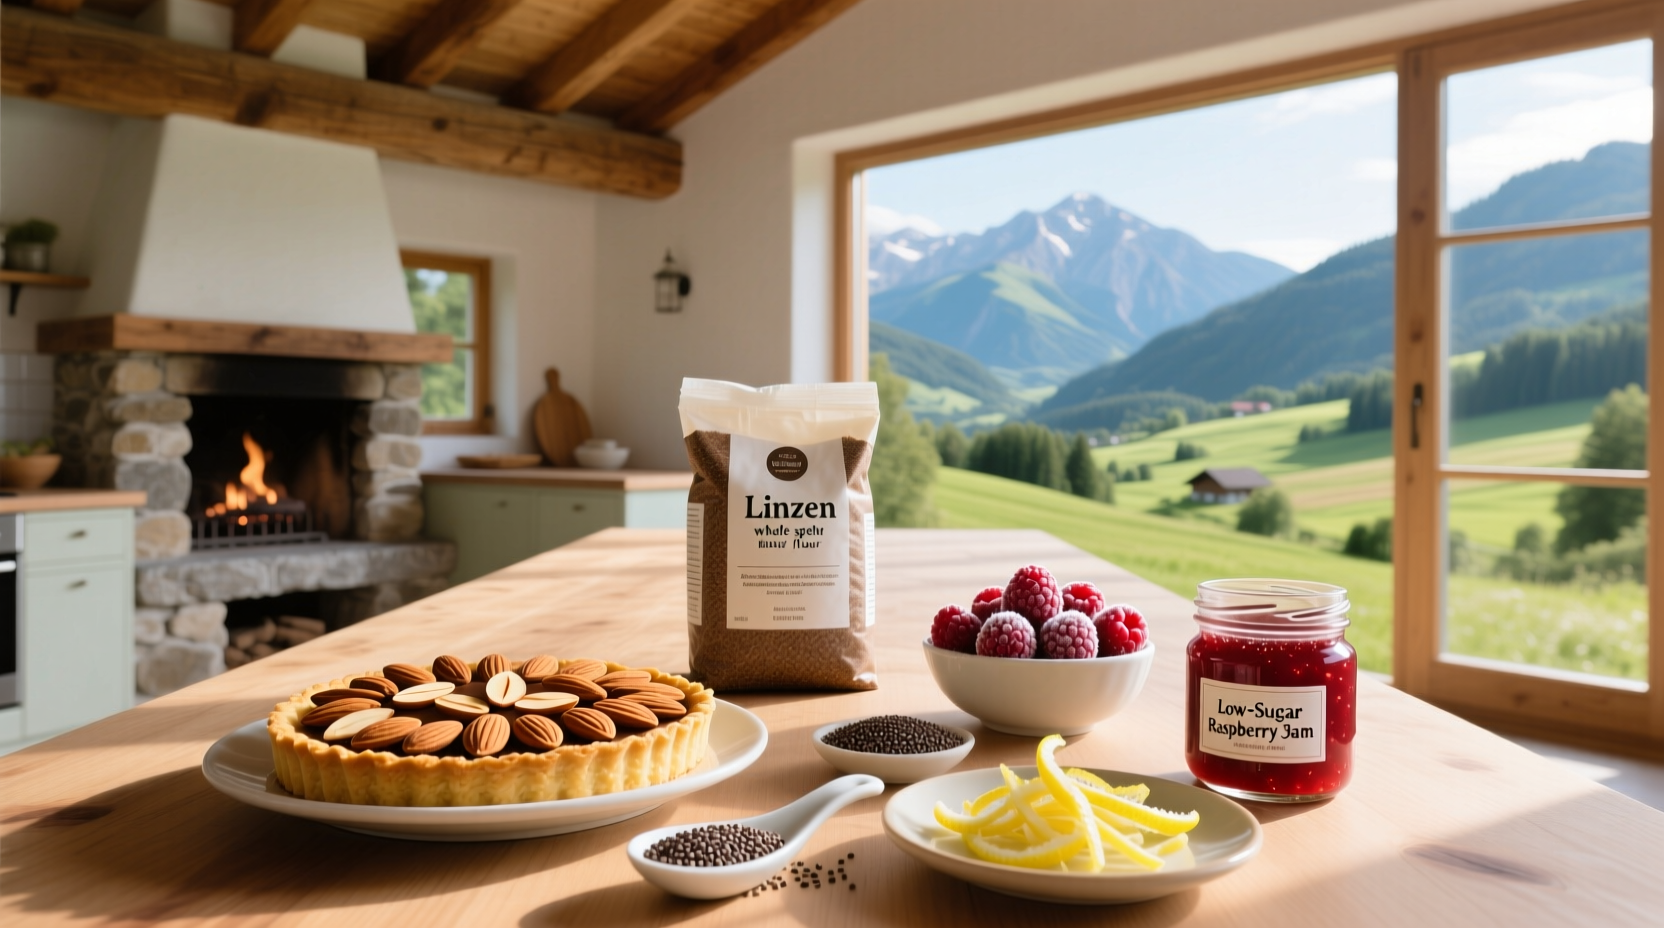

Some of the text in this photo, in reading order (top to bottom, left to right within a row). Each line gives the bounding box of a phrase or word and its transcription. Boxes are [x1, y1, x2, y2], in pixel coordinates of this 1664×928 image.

[745, 494, 837, 519] Linzen
[1218, 698, 1303, 722] Low-Sugar
[1208, 717, 1314, 743] Raspberry Jam
